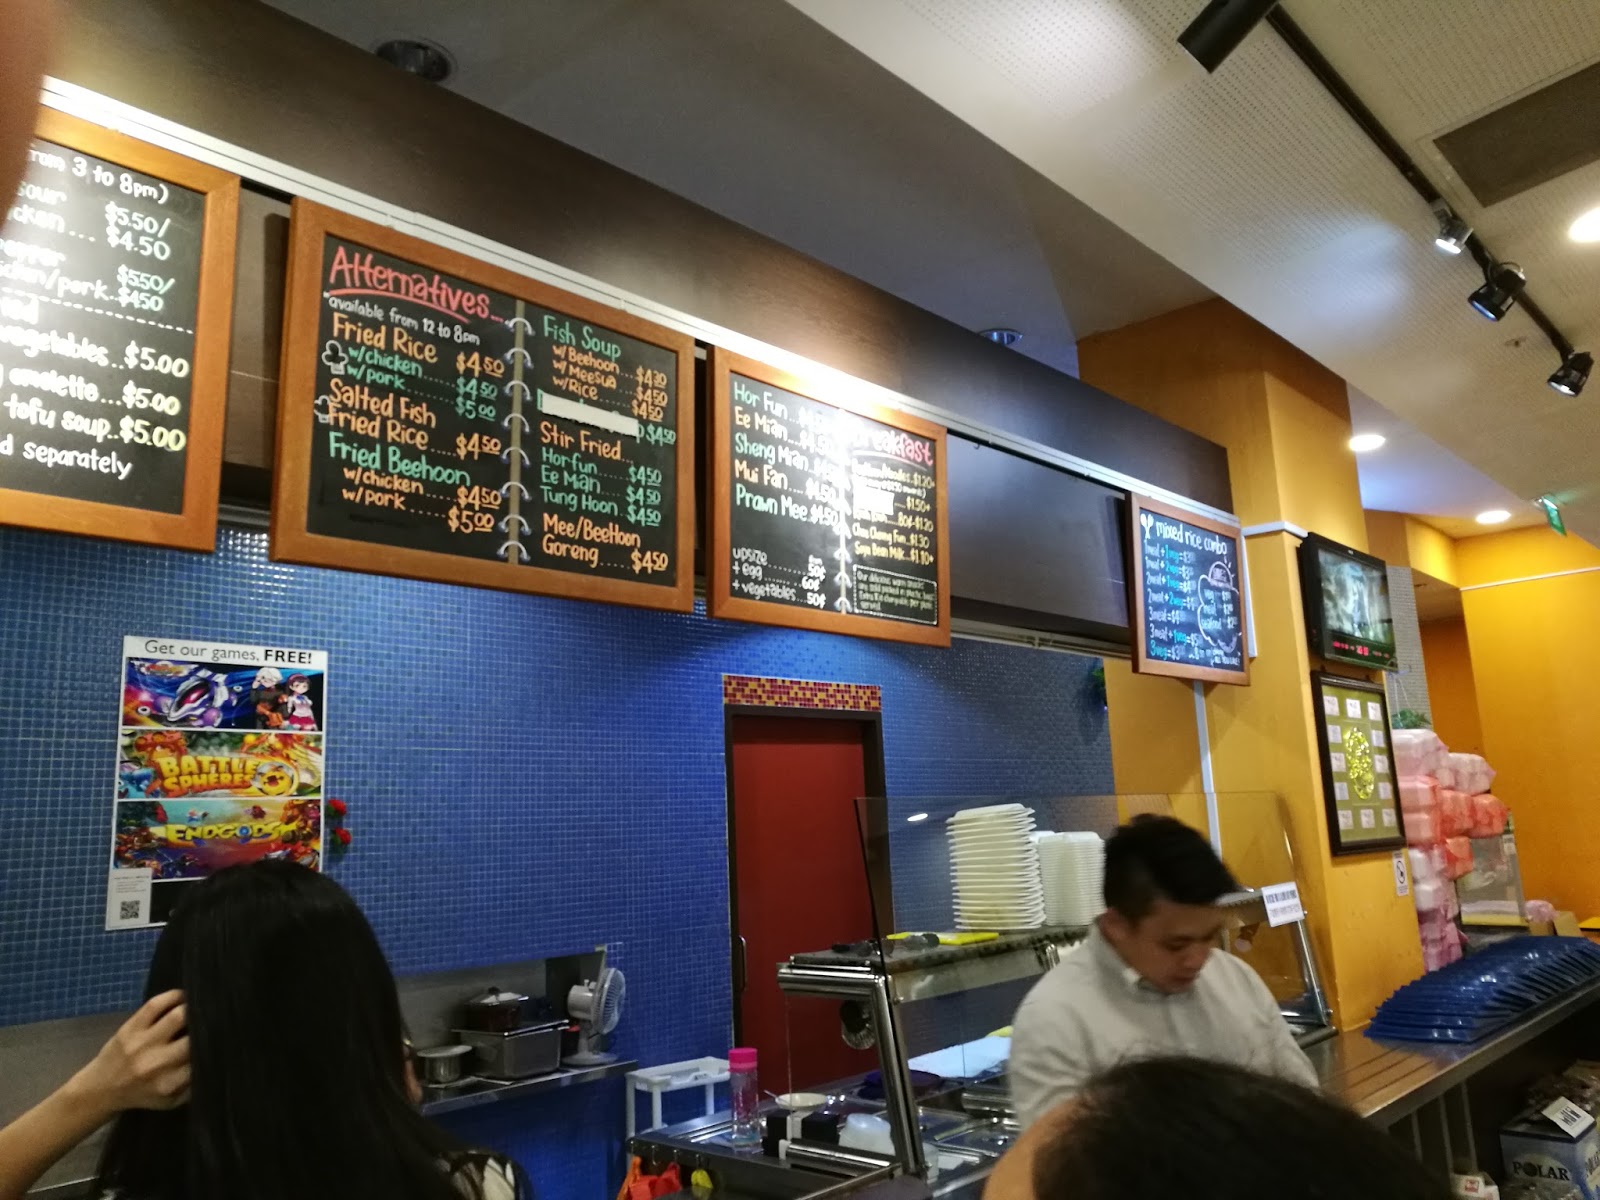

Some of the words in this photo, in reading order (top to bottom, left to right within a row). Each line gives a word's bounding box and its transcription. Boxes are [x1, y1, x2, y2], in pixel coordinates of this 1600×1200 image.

[30, 149, 65, 172] rom
[72, 156, 88, 177] 3
[93, 165, 114, 186] to
[120, 173, 169, 204] 8pm)
[329, 297, 384, 322] available
[389, 308, 418, 331] from
[422, 318, 435, 333] 12
[437, 323, 451, 338] to
[453, 325, 480, 346] 8pm
[333, 312, 387, 350] Fried
[393, 327, 438, 363] Rice
[544, 315, 576, 345] Fish
[581, 325, 621, 362] Soup
[124, 340, 190, 378] $5.00
[122, 380, 181, 416] $5.00
[329, 377, 394, 418] Salted
[400, 397, 436, 428] Fish
[734, 382, 760, 408] Hor
[763, 391, 788, 420] Fun
[3, 393, 56, 429] tofu
[61, 410, 111, 443] soup
[119, 415, 187, 451] $5.00
[329, 402, 381, 438] Fried
[387, 420, 428, 450] Rice
[540, 421, 575, 449] Stir
[734, 406, 751, 429] Ee
[754, 412, 788, 441] Mian
[23, 441, 133, 481] separately
[329, 431, 381, 469] Fried
[388, 446, 470, 486] Beehoon
[735, 432, 775, 465] Sheng
[778, 445, 809, 472] Mian
[541, 465, 559, 484] Ee
[734, 458, 759, 483] Mui
[763, 464, 788, 491] Fan
[540, 485, 578, 512] Tung
[582, 494, 618, 517] Hoon
[736, 483, 778, 515] Prawn
[781, 494, 808, 521] Mee
[542, 534, 599, 569] Goreng
[1156, 521, 1184, 543] mixed
[1185, 531, 1203, 550] rice
[1204, 535, 1227, 555] combo
[732, 547, 768, 566] upsize
[742, 562, 762, 581] egg
[741, 582, 796, 602] vegetables
[144, 640, 175, 656] Get
[180, 643, 207, 657] our
[264, 649, 312, 665] FREE!
[155, 756, 262, 776] BATTLE
[1512, 1161, 1570, 1181] POLAR
